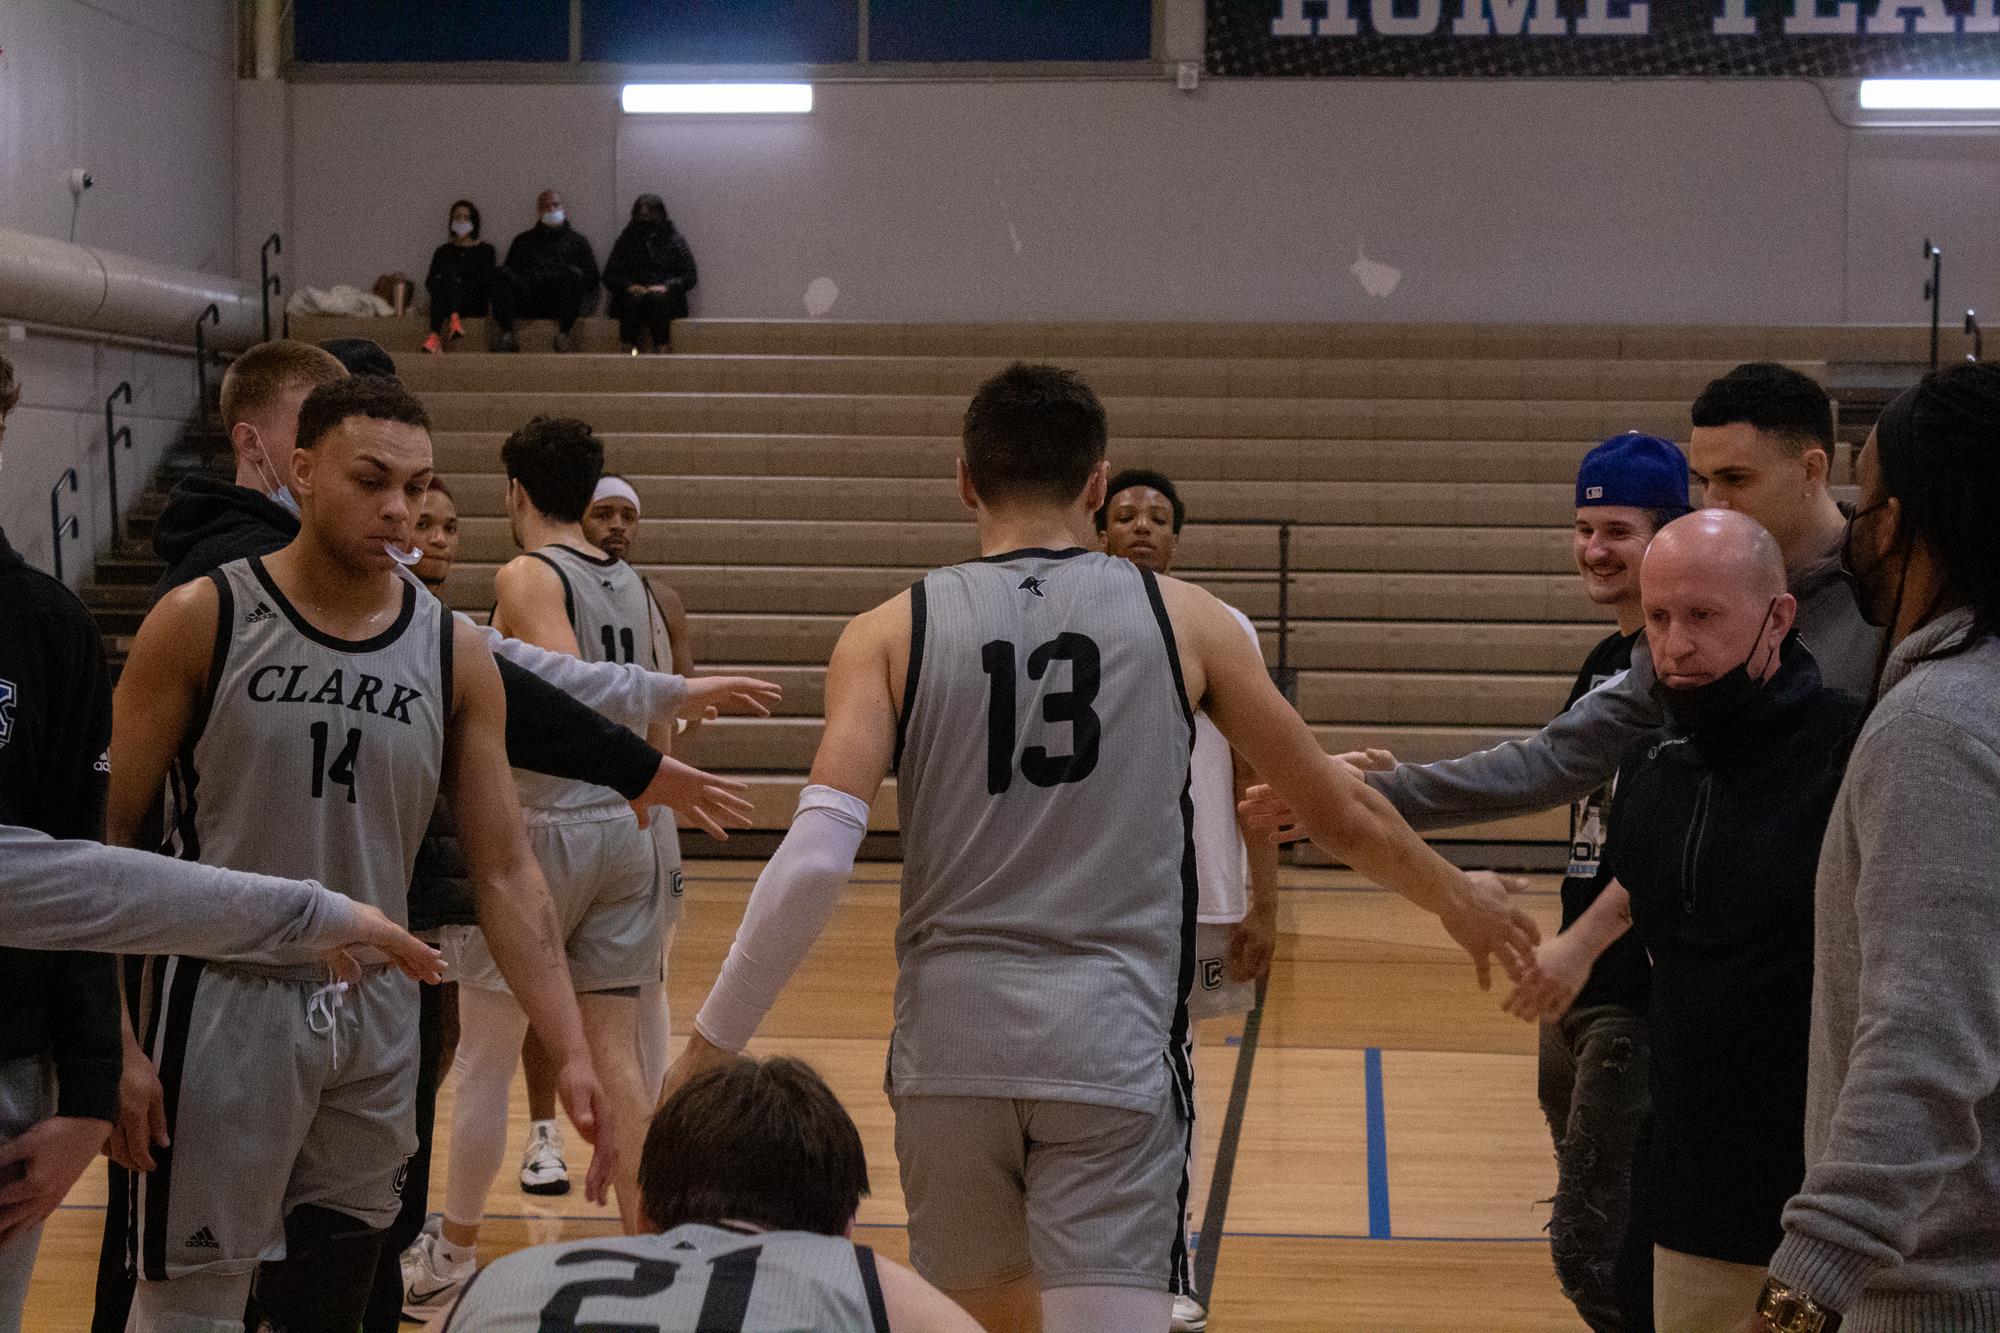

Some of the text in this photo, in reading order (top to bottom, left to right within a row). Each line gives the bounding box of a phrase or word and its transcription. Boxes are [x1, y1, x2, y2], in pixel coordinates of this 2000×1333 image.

[247, 664, 423, 725] CLARK
[981, 631, 1101, 796] 13
[310, 720, 362, 804] 14
[538, 1244, 764, 1333] 21
